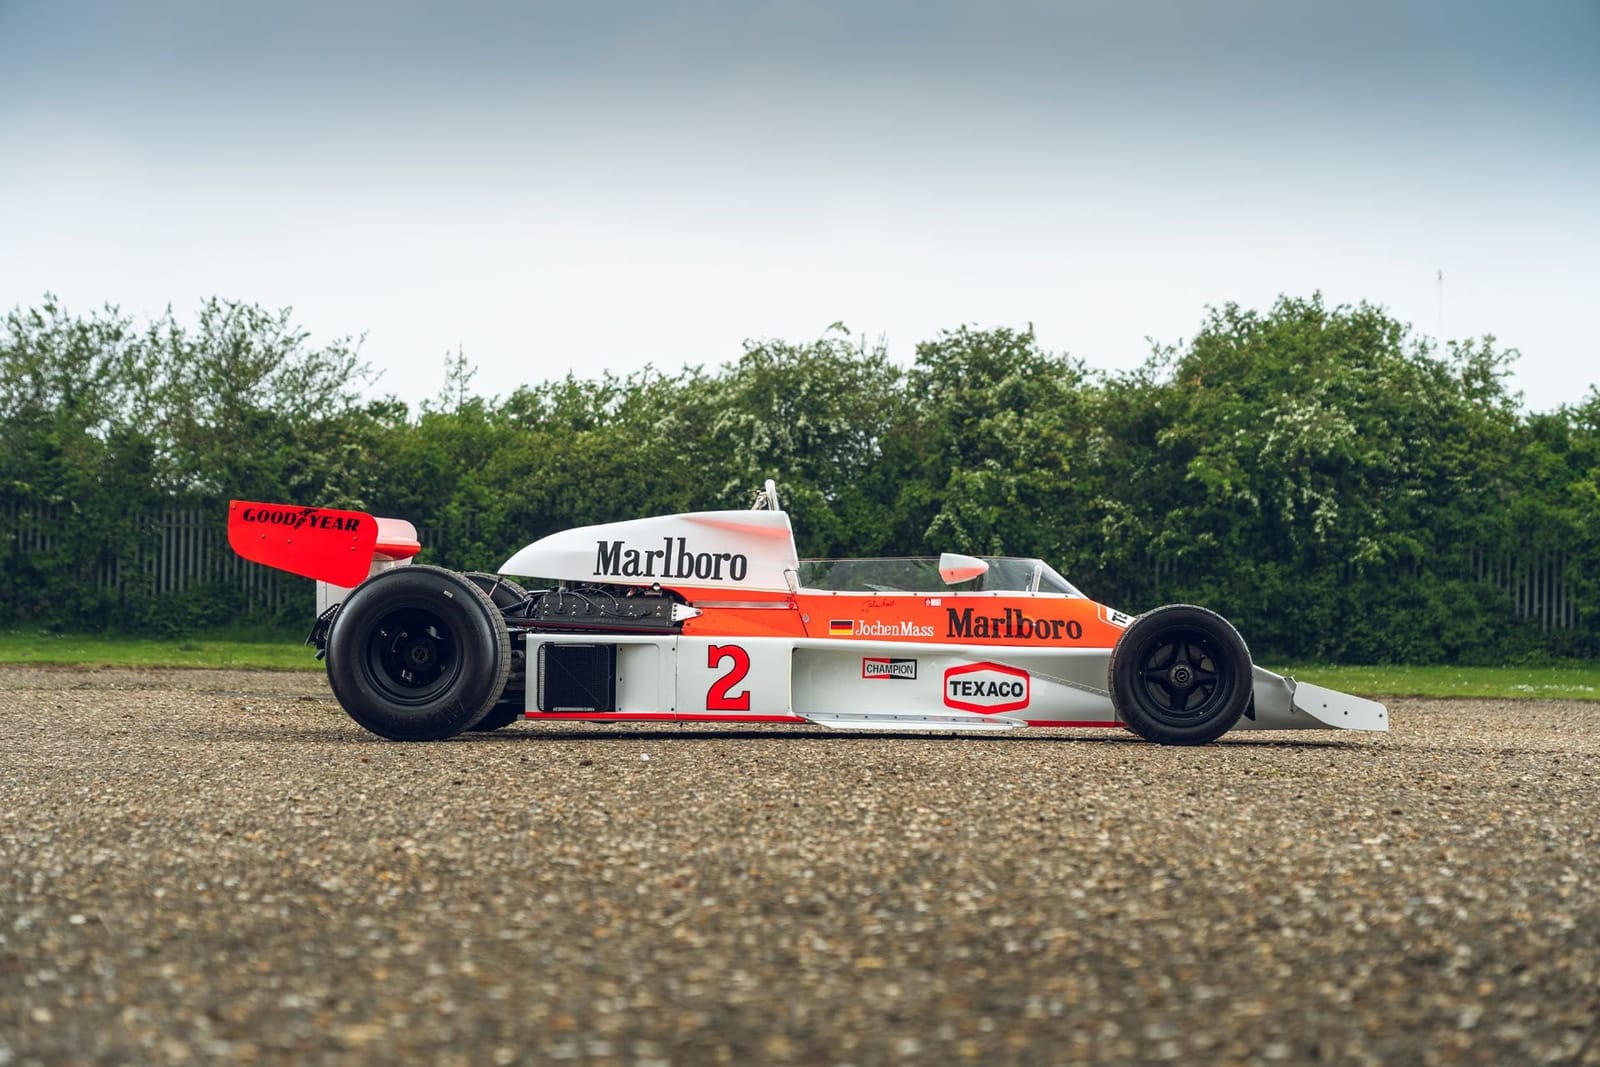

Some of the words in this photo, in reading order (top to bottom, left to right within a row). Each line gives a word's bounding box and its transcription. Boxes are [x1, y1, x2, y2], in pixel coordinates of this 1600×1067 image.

[243, 508, 360, 532] GOODYEAR
[593, 537, 748, 581] Marlboro
[855, 620, 899, 636] Jochen
[900, 621, 934, 637] Mass
[947, 608, 1082, 641] Marlboro
[706, 644, 751, 711] 2
[866, 663, 914, 675] CHAMPION
[949, 680, 1024, 698] TEXACO
